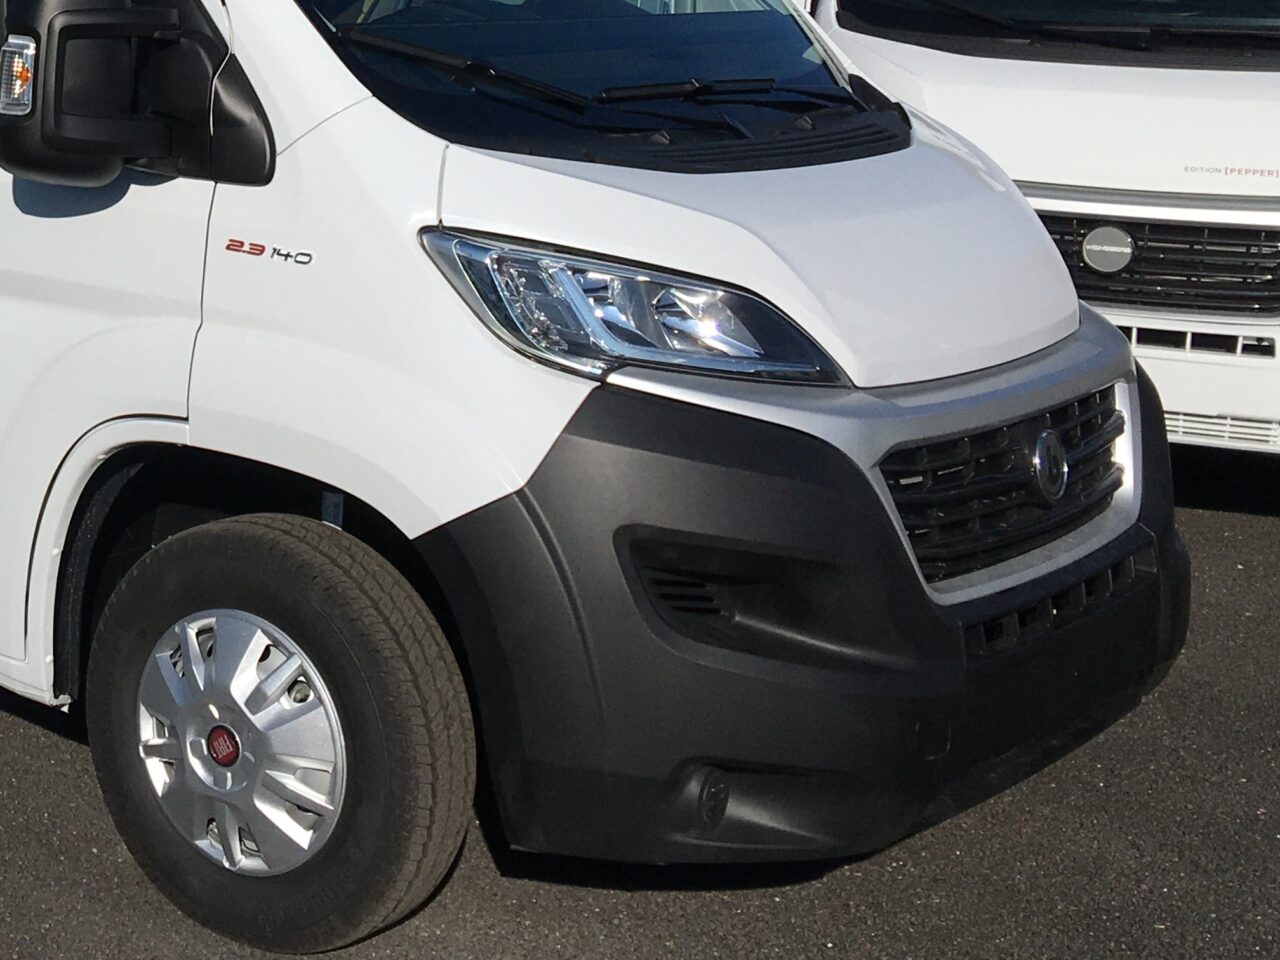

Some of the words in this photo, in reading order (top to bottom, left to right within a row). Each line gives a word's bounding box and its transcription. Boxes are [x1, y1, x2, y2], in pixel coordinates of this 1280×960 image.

[1184, 166, 1222, 174] EDITION
[270, 247, 313, 265] 140
[213, 734, 234, 759] FIAT
